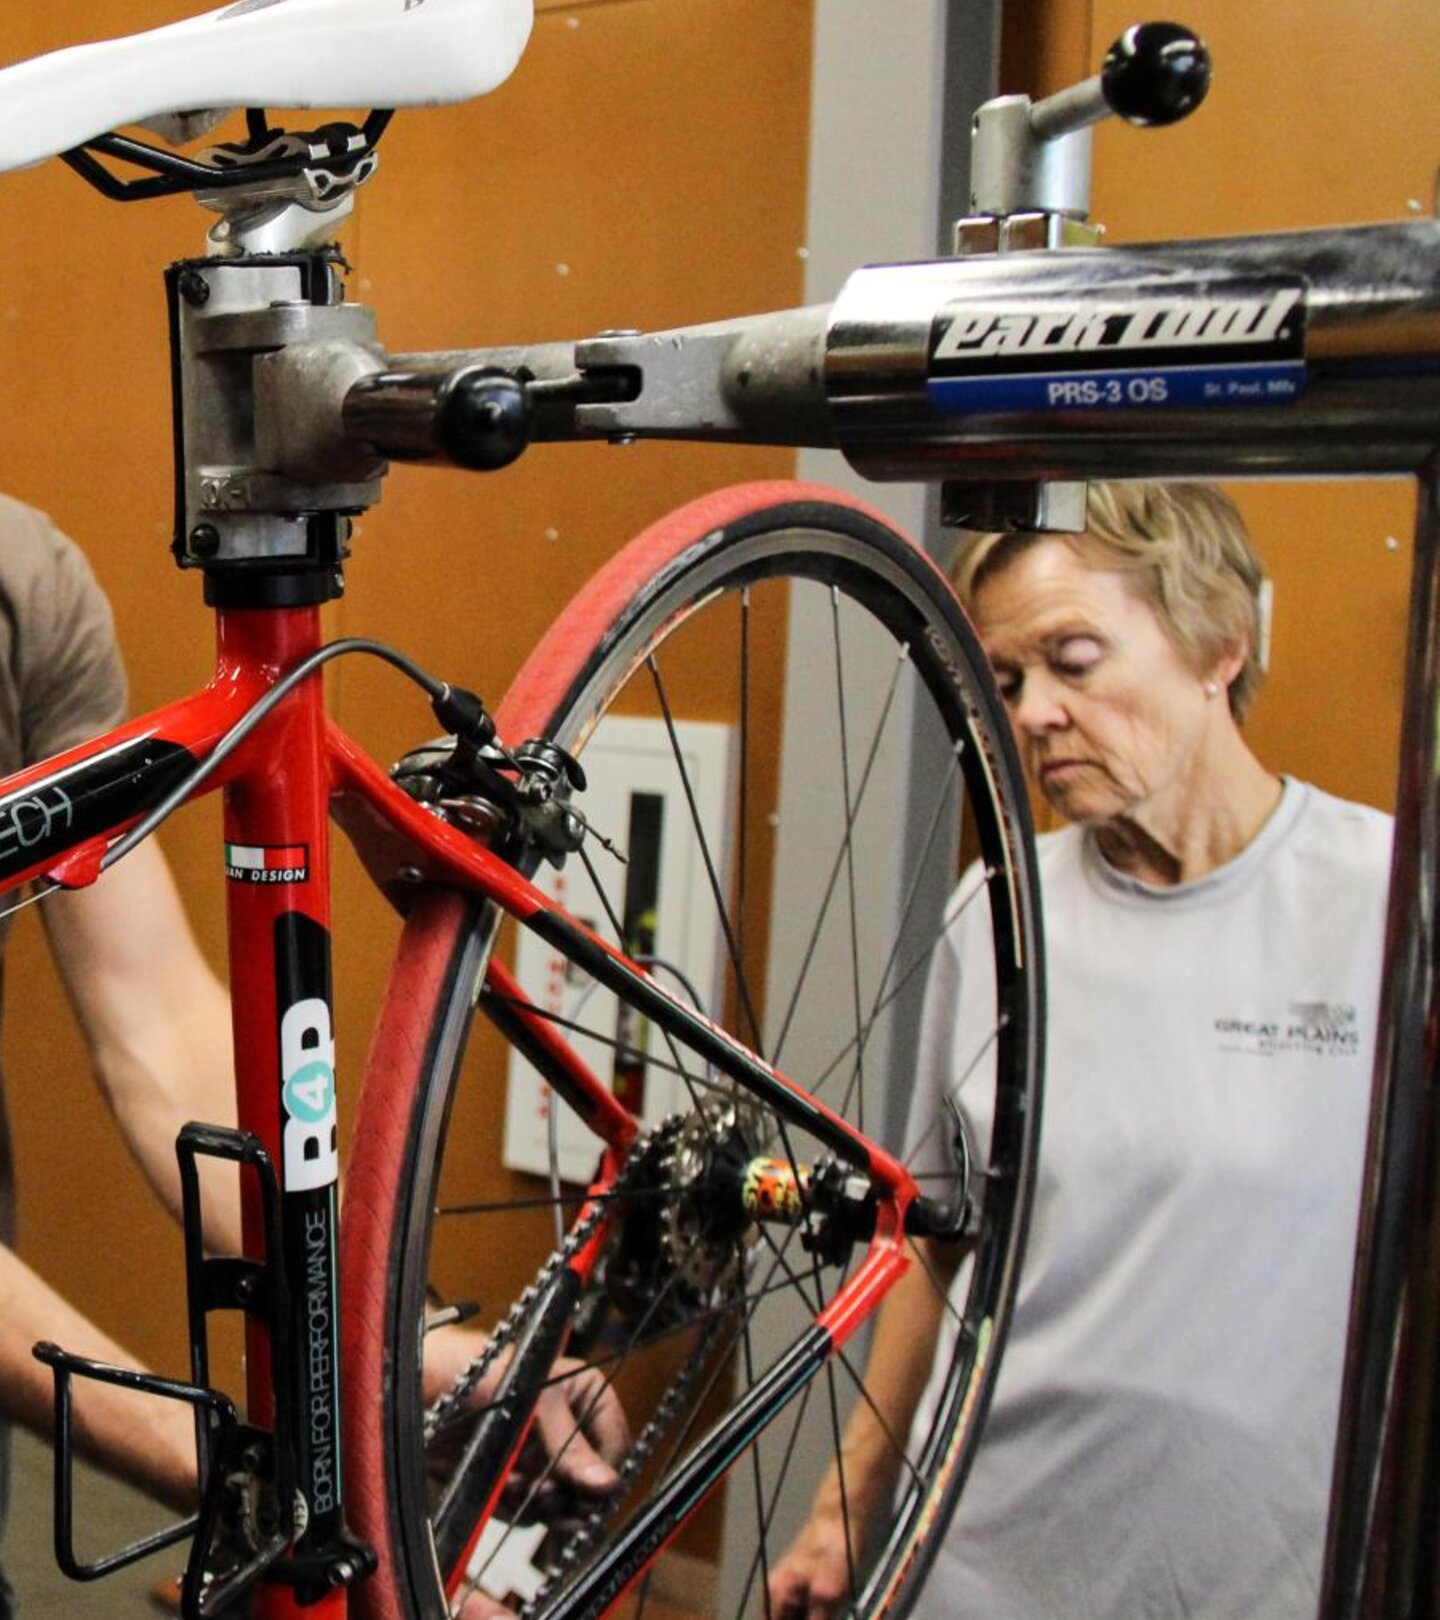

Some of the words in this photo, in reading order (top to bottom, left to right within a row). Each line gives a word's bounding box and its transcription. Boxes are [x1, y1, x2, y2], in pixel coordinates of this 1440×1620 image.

[1047, 383, 1122, 406] PRS-3
[1128, 379, 1168, 402] OS
[251, 869, 306, 882] DESIGN
[305, 1208, 331, 1392] PERFORMANCE
